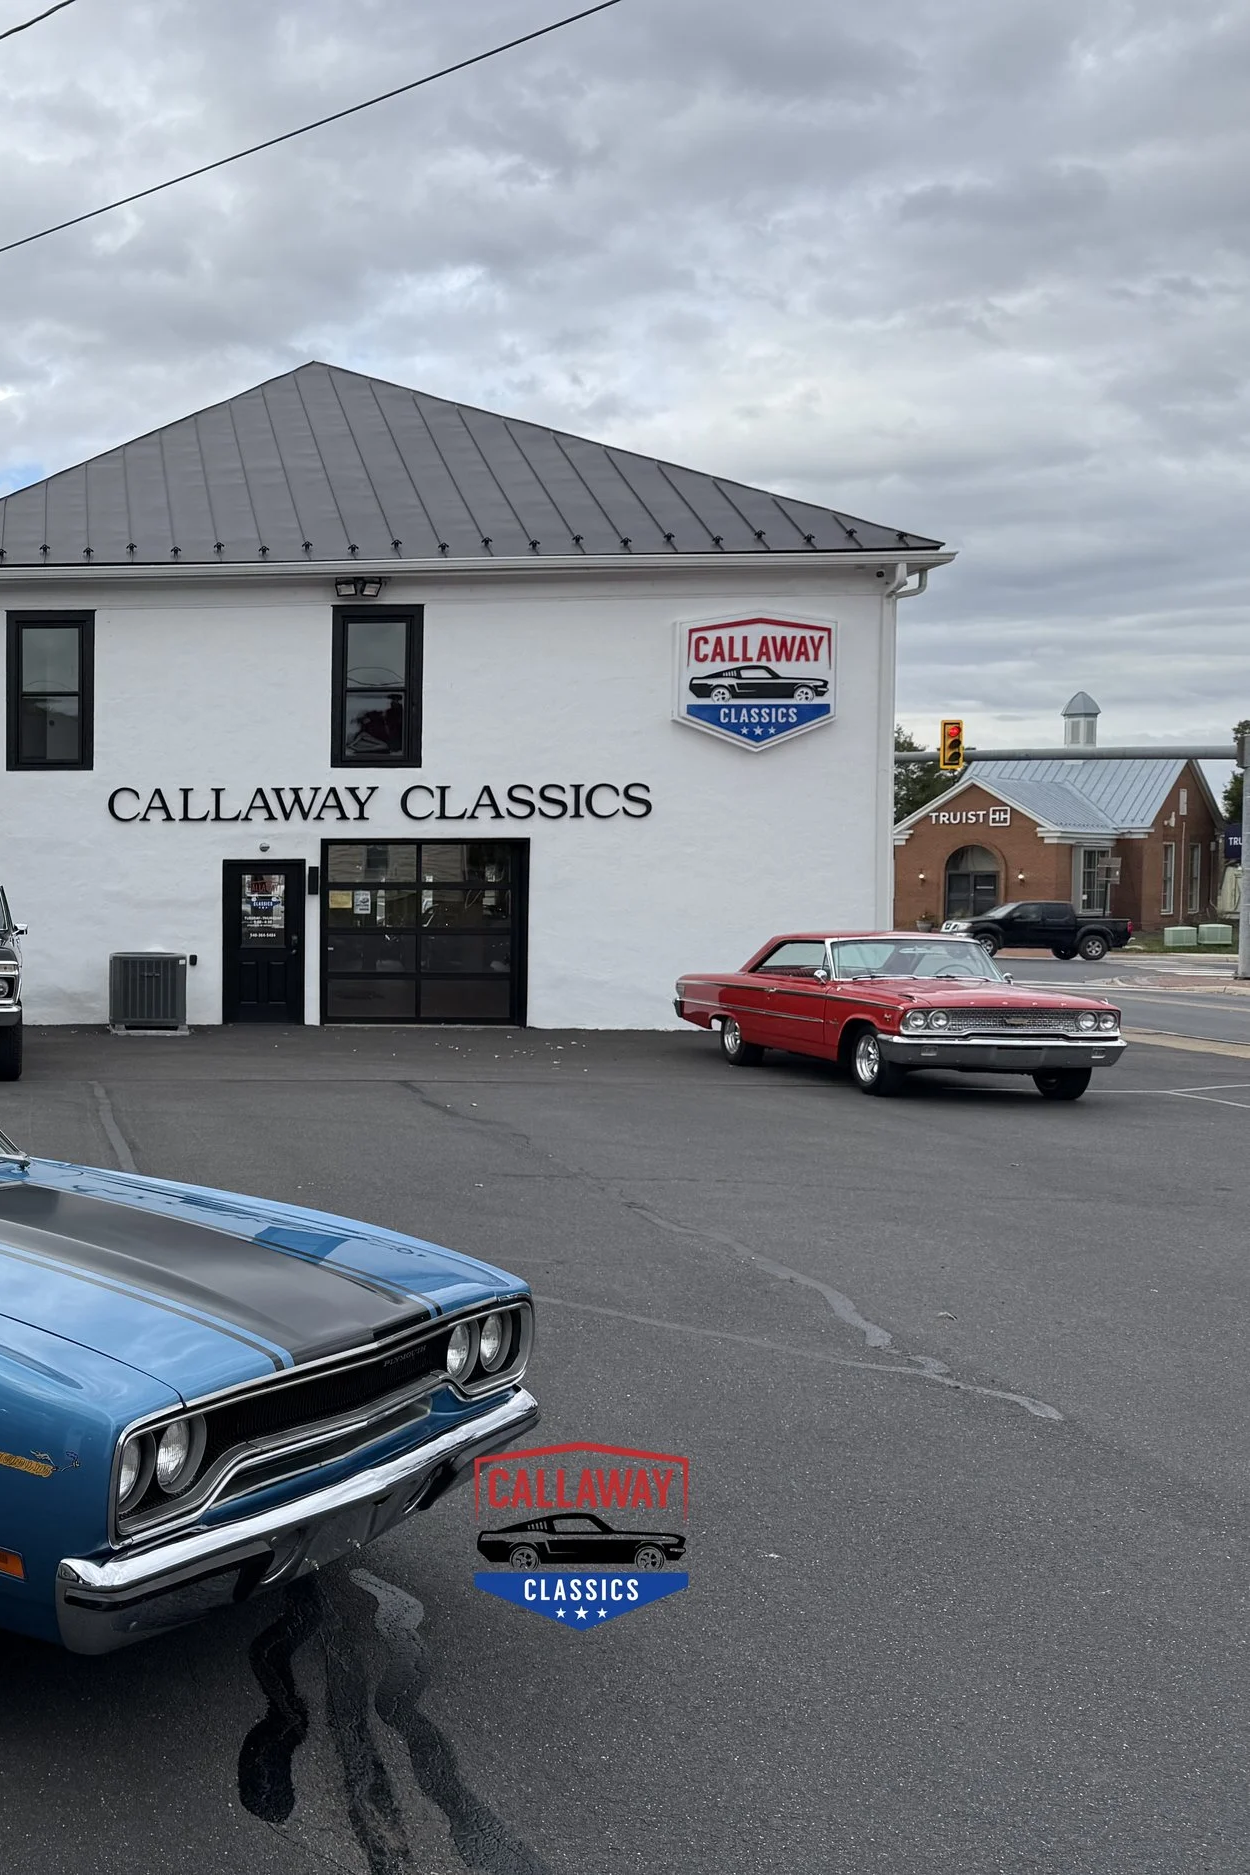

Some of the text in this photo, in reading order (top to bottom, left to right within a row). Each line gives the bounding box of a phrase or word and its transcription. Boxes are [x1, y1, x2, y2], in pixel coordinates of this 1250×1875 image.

[694, 635, 825, 663] CALLAWAY
[719, 707, 798, 723] CLASSICS
[108, 782, 653, 822] CALLAWAY CLASSICS
[929, 811, 987, 825] TRUIST
